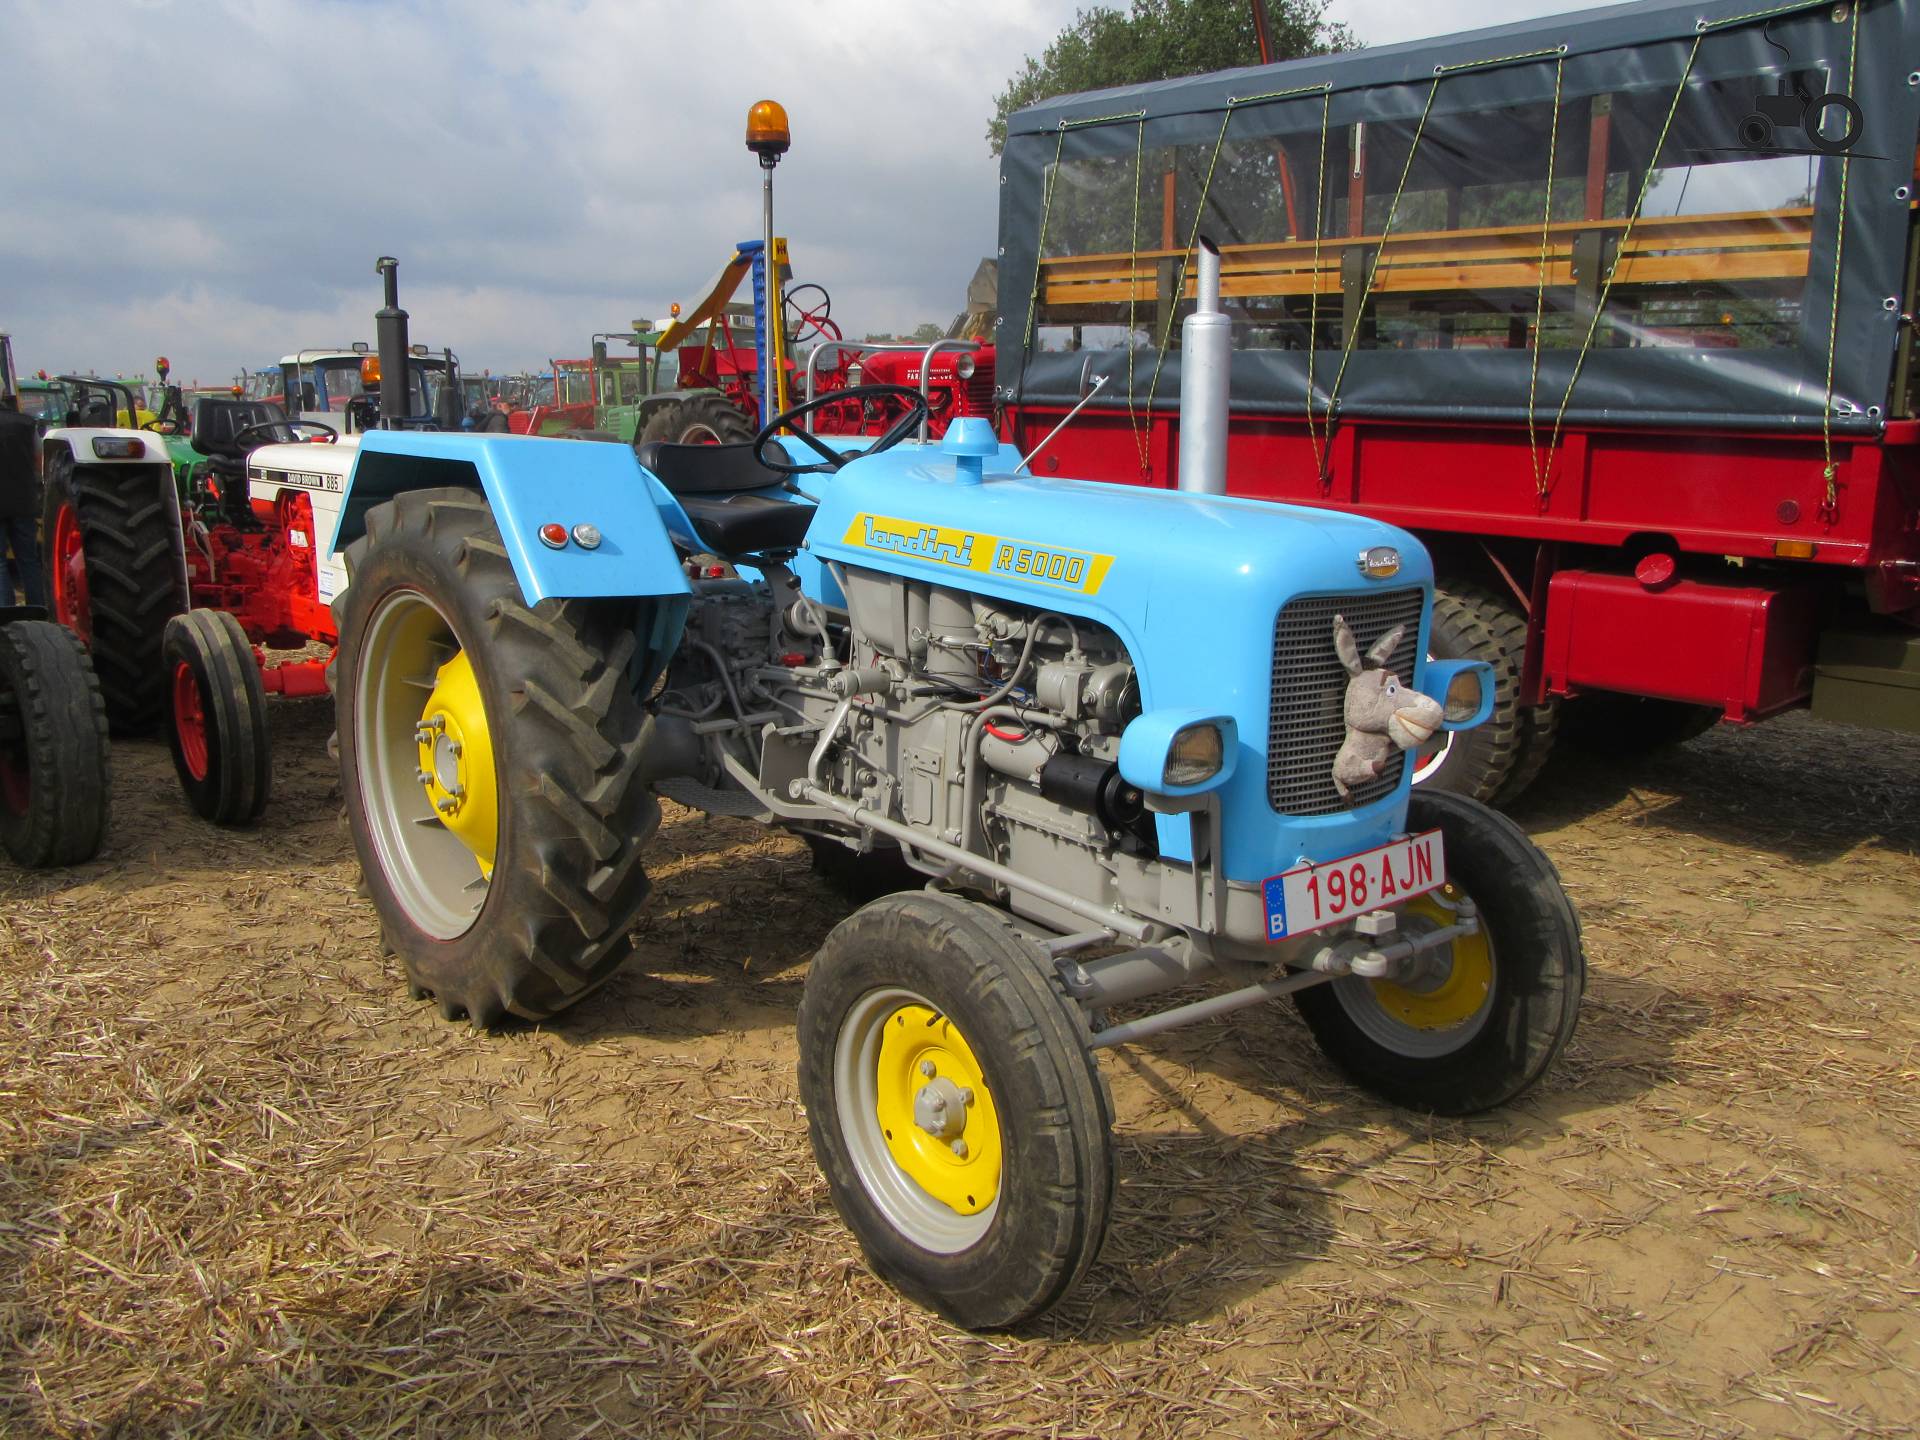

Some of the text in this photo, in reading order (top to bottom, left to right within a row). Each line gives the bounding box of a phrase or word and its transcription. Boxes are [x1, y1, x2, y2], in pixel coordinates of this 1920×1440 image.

[287, 472, 339, 490] DAVID BROWN 885
[1270, 913, 1285, 935] B
